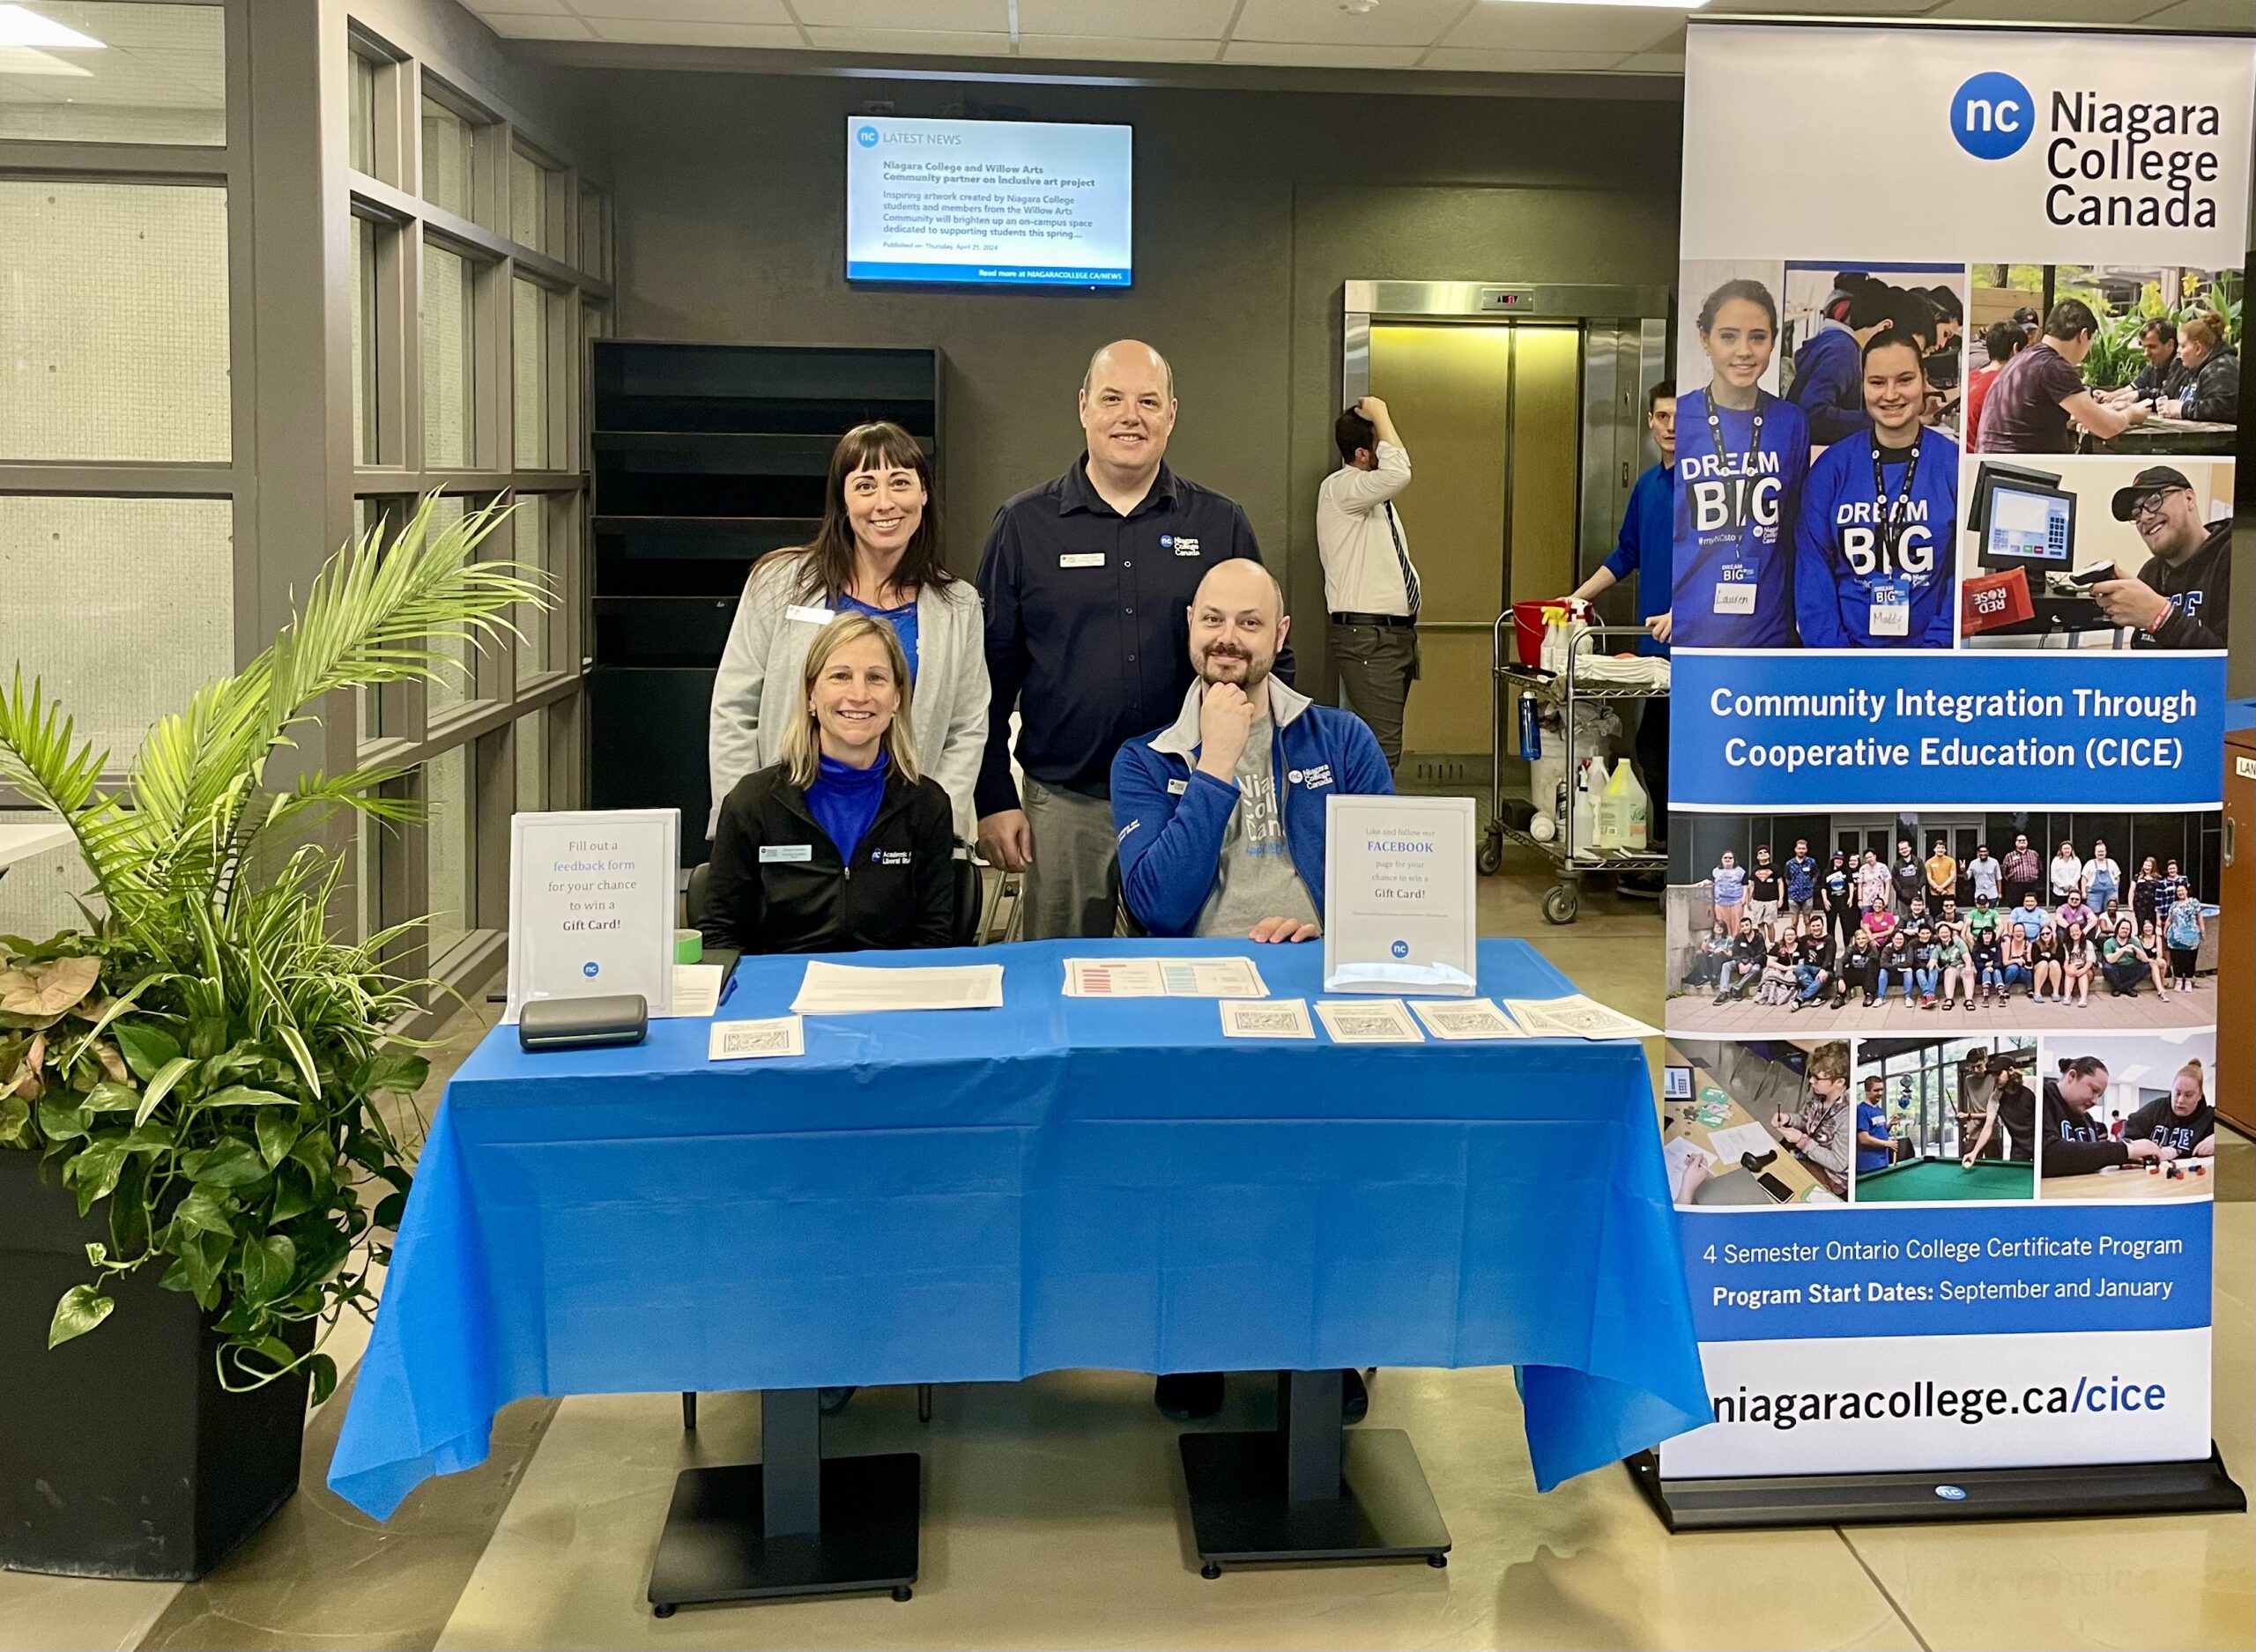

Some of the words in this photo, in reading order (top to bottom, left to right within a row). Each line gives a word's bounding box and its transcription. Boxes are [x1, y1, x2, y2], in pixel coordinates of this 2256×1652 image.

[1965, 98, 2020, 132] nc
[2051, 90, 2220, 144] Niagara
[860, 132, 875, 141] nc
[883, 133, 924, 144] LATEST
[927, 134, 961, 145] NEWS
[883, 160, 923, 172] Niagara
[925, 162, 961, 173] College
[985, 165, 1020, 174] Willow
[1022, 166, 1043, 174] Arts
[2046, 137, 2219, 191] College
[883, 173, 941, 184] Community
[943, 174, 980, 184] partner
[1060, 178, 1095, 189] project
[883, 190, 921, 202] Inspiring
[924, 192, 957, 201] artwork
[994, 194, 1005, 204] by
[1006, 194, 1041, 204] Niagara
[1043, 195, 1075, 205] College
[883, 202, 920, 211] students
[923, 203, 939, 211] and
[941, 204, 983, 212] members
[984, 204, 1005, 213] from
[1007, 205, 1021, 214] the
[1023, 206, 1053, 215] Willow
[2045, 184, 2218, 229] Canada
[883, 213, 933, 225] Community
[954, 216, 990, 226] brighten
[992, 218, 1004, 226] up
[1019, 219, 1067, 227] on-campus
[883, 224, 925, 233] dedicated
[940, 226, 988, 237] supporting
[990, 226, 1027, 237] students
[1028, 227, 1044, 237] this
[978, 269, 997, 278] Read
[1694, 477, 1782, 531] BIG
[1724, 570, 1744, 581] BIG
[1876, 592, 1896, 603] BIG
[1978, 599, 2006, 614] RED
[1711, 686, 1887, 723] Community
[1896, 688, 2064, 723] Integration
[2072, 689, 2197, 723] Through
[1725, 737, 1911, 773] Cooperative
[1919, 738, 2075, 767] Education
[2085, 737, 2184, 769] (CICE)
[1302, 764, 1330, 776] Niagara
[1304, 771, 1332, 782] College
[1307, 777, 1333, 790] Canada
[1398, 828, 1421, 837] follow
[568, 841, 587, 852] Fill
[590, 842, 609, 852] out
[1368, 841, 1434, 853] FACEBOOK
[553, 860, 605, 872] feedback
[607, 860, 635, 870] form
[548, 881, 564, 893] for
[567, 883, 593, 895] your
[597, 880, 637, 891] chance
[1375, 888, 1394, 899] Gift
[1396, 889, 1426, 899] Card!
[569, 901, 582, 911] to
[584, 900, 605, 910] win
[563, 920, 586, 931] Gift
[588, 919, 621, 930] Card!
[1393, 945, 1406, 953] nc
[1703, 1244, 1718, 1264] 4
[1724, 1241, 1820, 1264] Semester
[1825, 1239, 1899, 1263] Ontario
[1905, 1238, 1981, 1264] College
[1986, 1235, 2093, 1259] Certificate
[2097, 1234, 2184, 1261] Program
[1712, 1286, 1802, 1309] Program
[1807, 1284, 1861, 1306] Start
[1867, 1281, 1933, 1304] Dates:
[1939, 1278, 2051, 1306] September
[2054, 1278, 2091, 1299] and
[2096, 1278, 2173, 1302] January
[1712, 1375, 2166, 1430] niagaracollege.ca/cice
